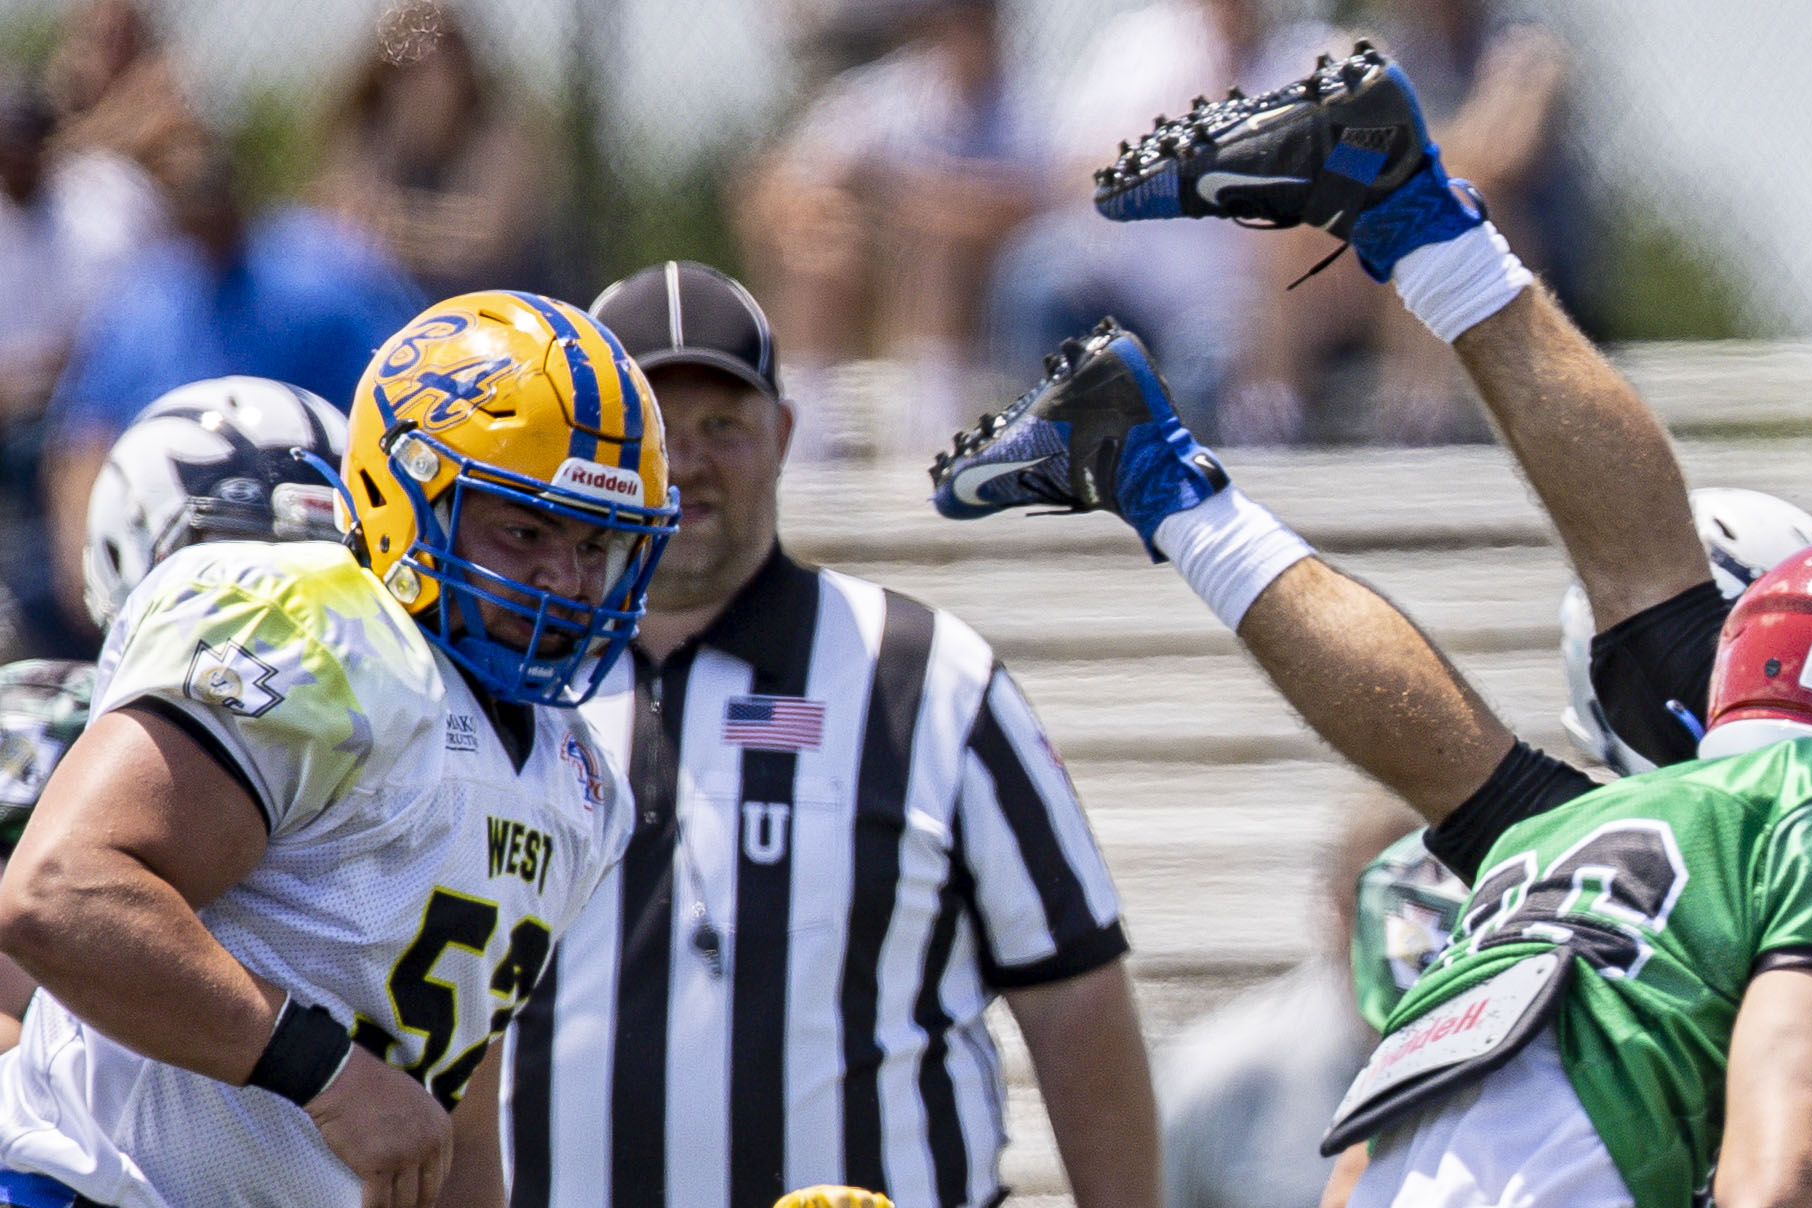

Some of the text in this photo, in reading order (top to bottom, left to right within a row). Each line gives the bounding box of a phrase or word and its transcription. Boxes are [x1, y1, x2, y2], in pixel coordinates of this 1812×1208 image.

[571, 466, 638, 496] Riddell
[486, 814, 554, 896] WEST
[743, 801, 791, 865] U
